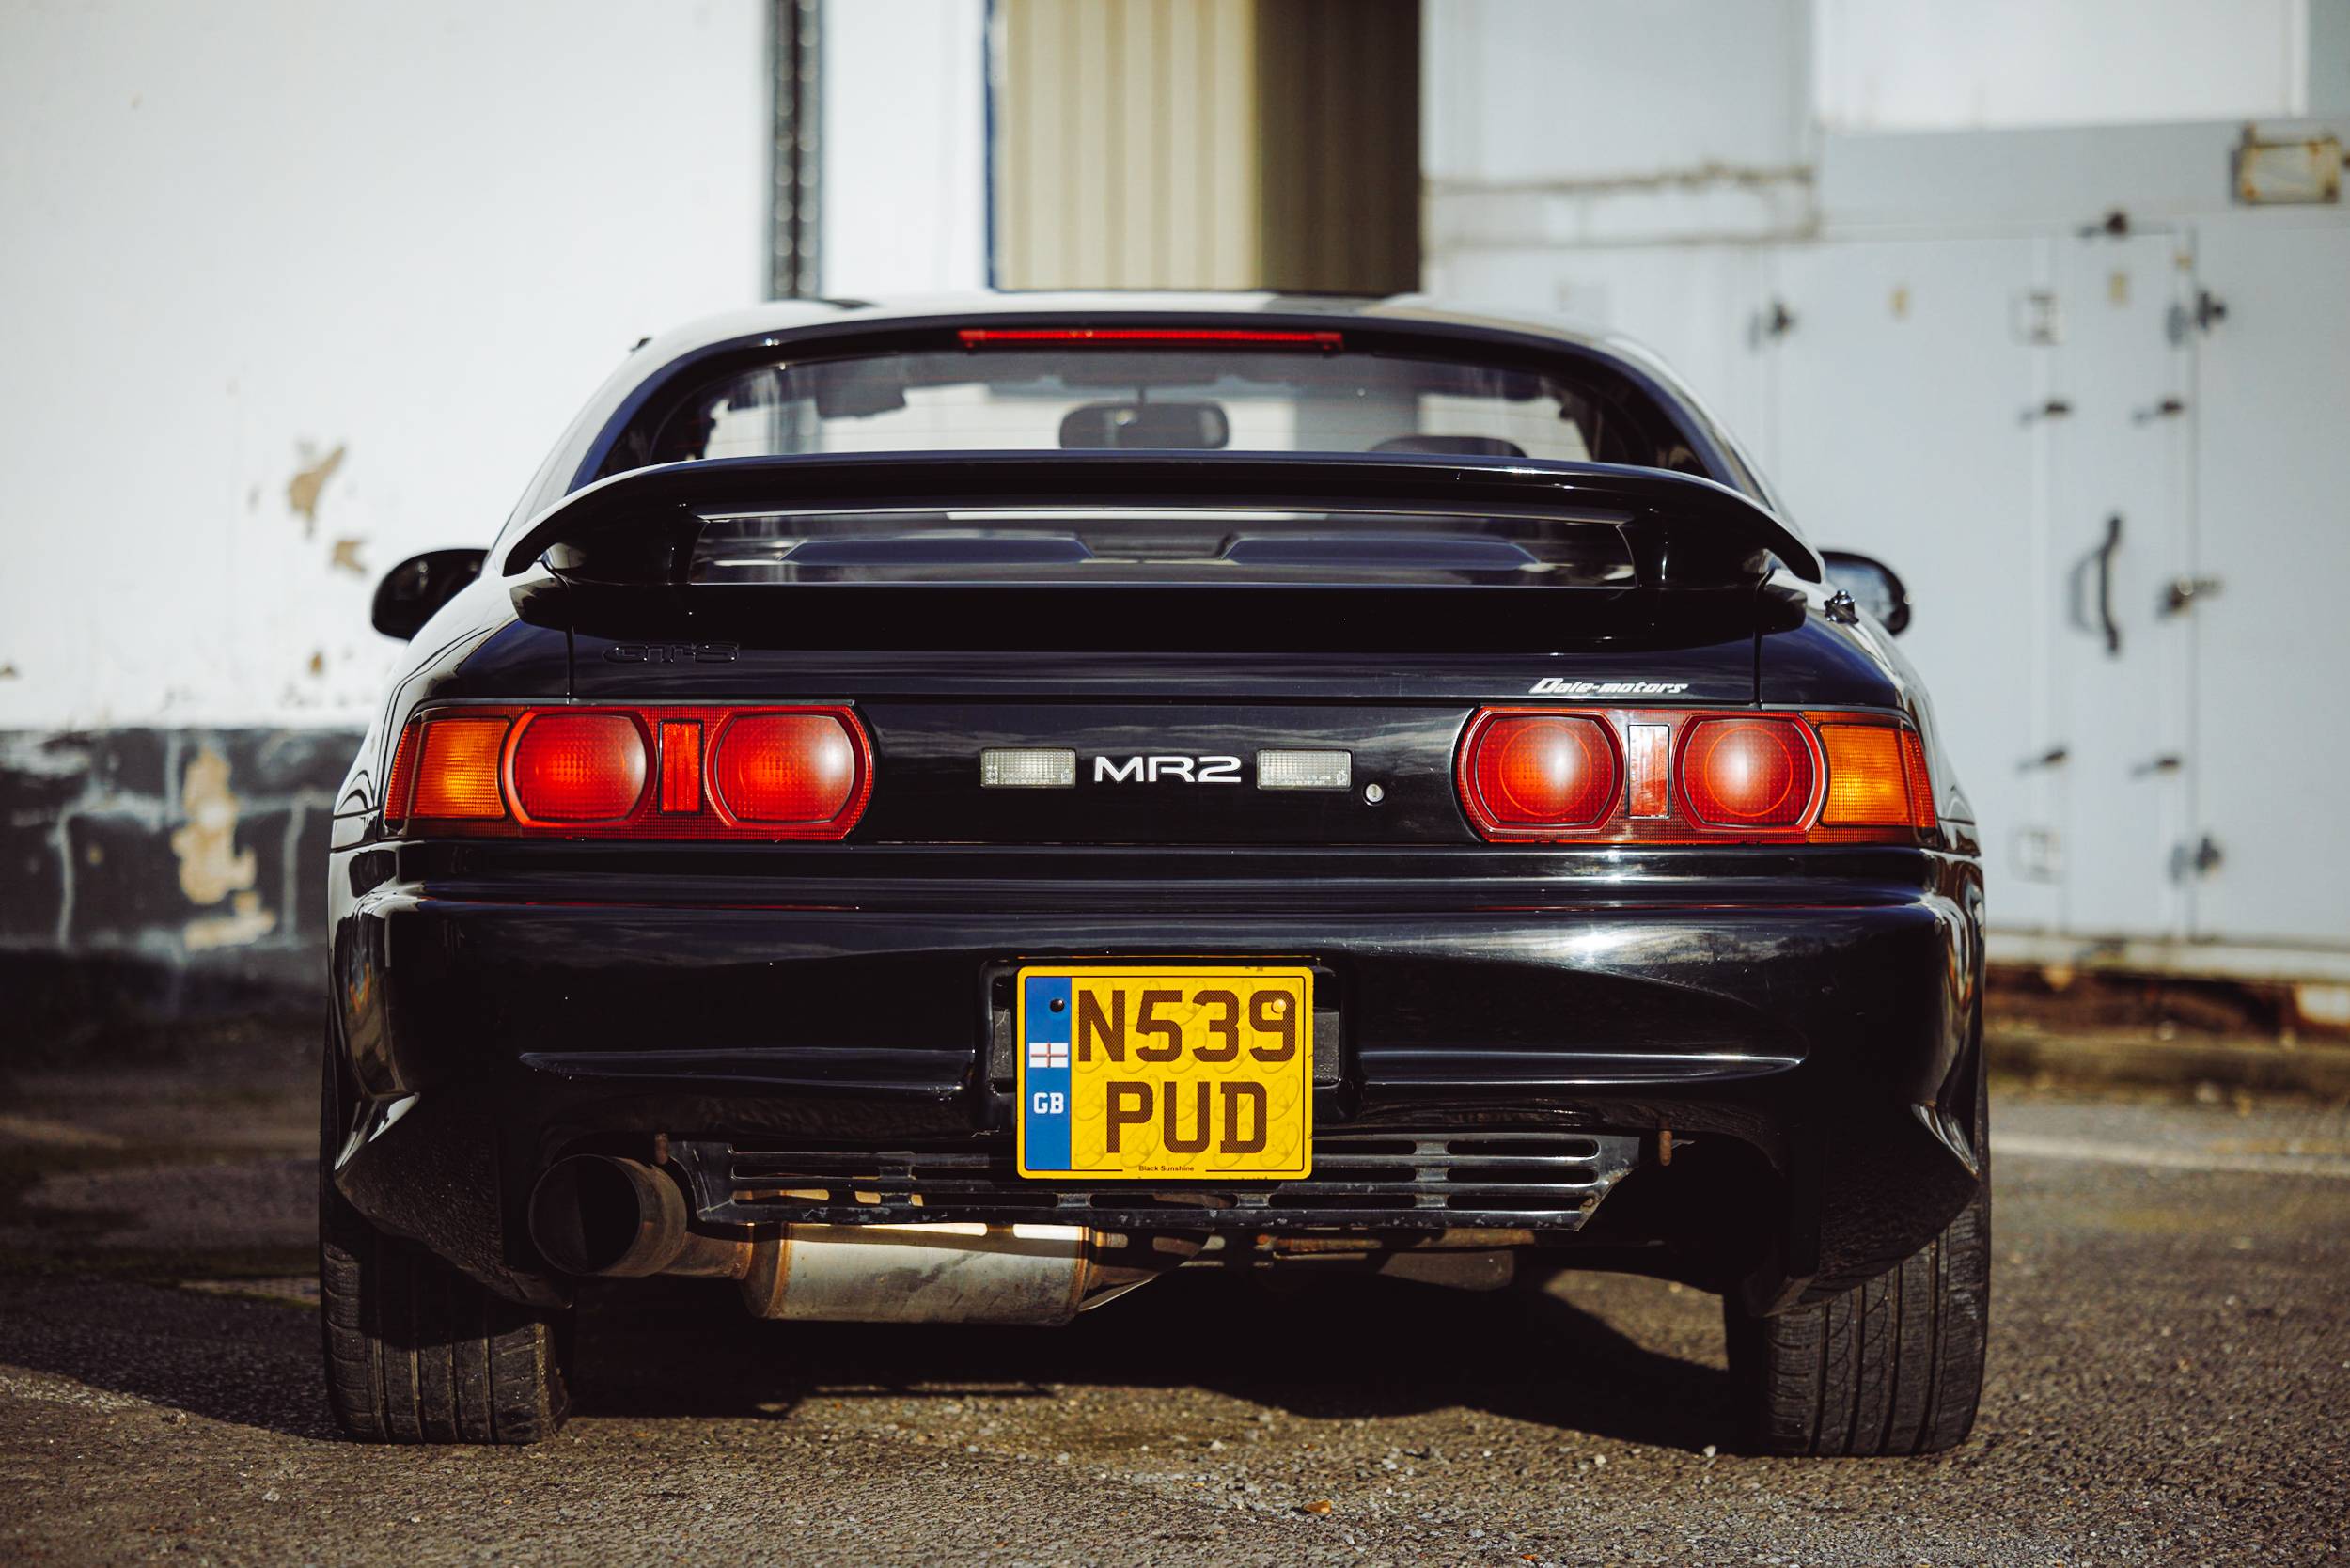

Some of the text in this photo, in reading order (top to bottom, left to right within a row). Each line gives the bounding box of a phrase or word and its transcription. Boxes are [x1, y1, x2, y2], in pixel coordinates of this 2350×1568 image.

[1528, 677, 1689, 694] Dale-motors
[1093, 755, 1242, 783] MR2
[1078, 990, 1296, 1062] N539
[1033, 1092, 1064, 1114] GB
[1106, 1081, 1267, 1153] PUD
